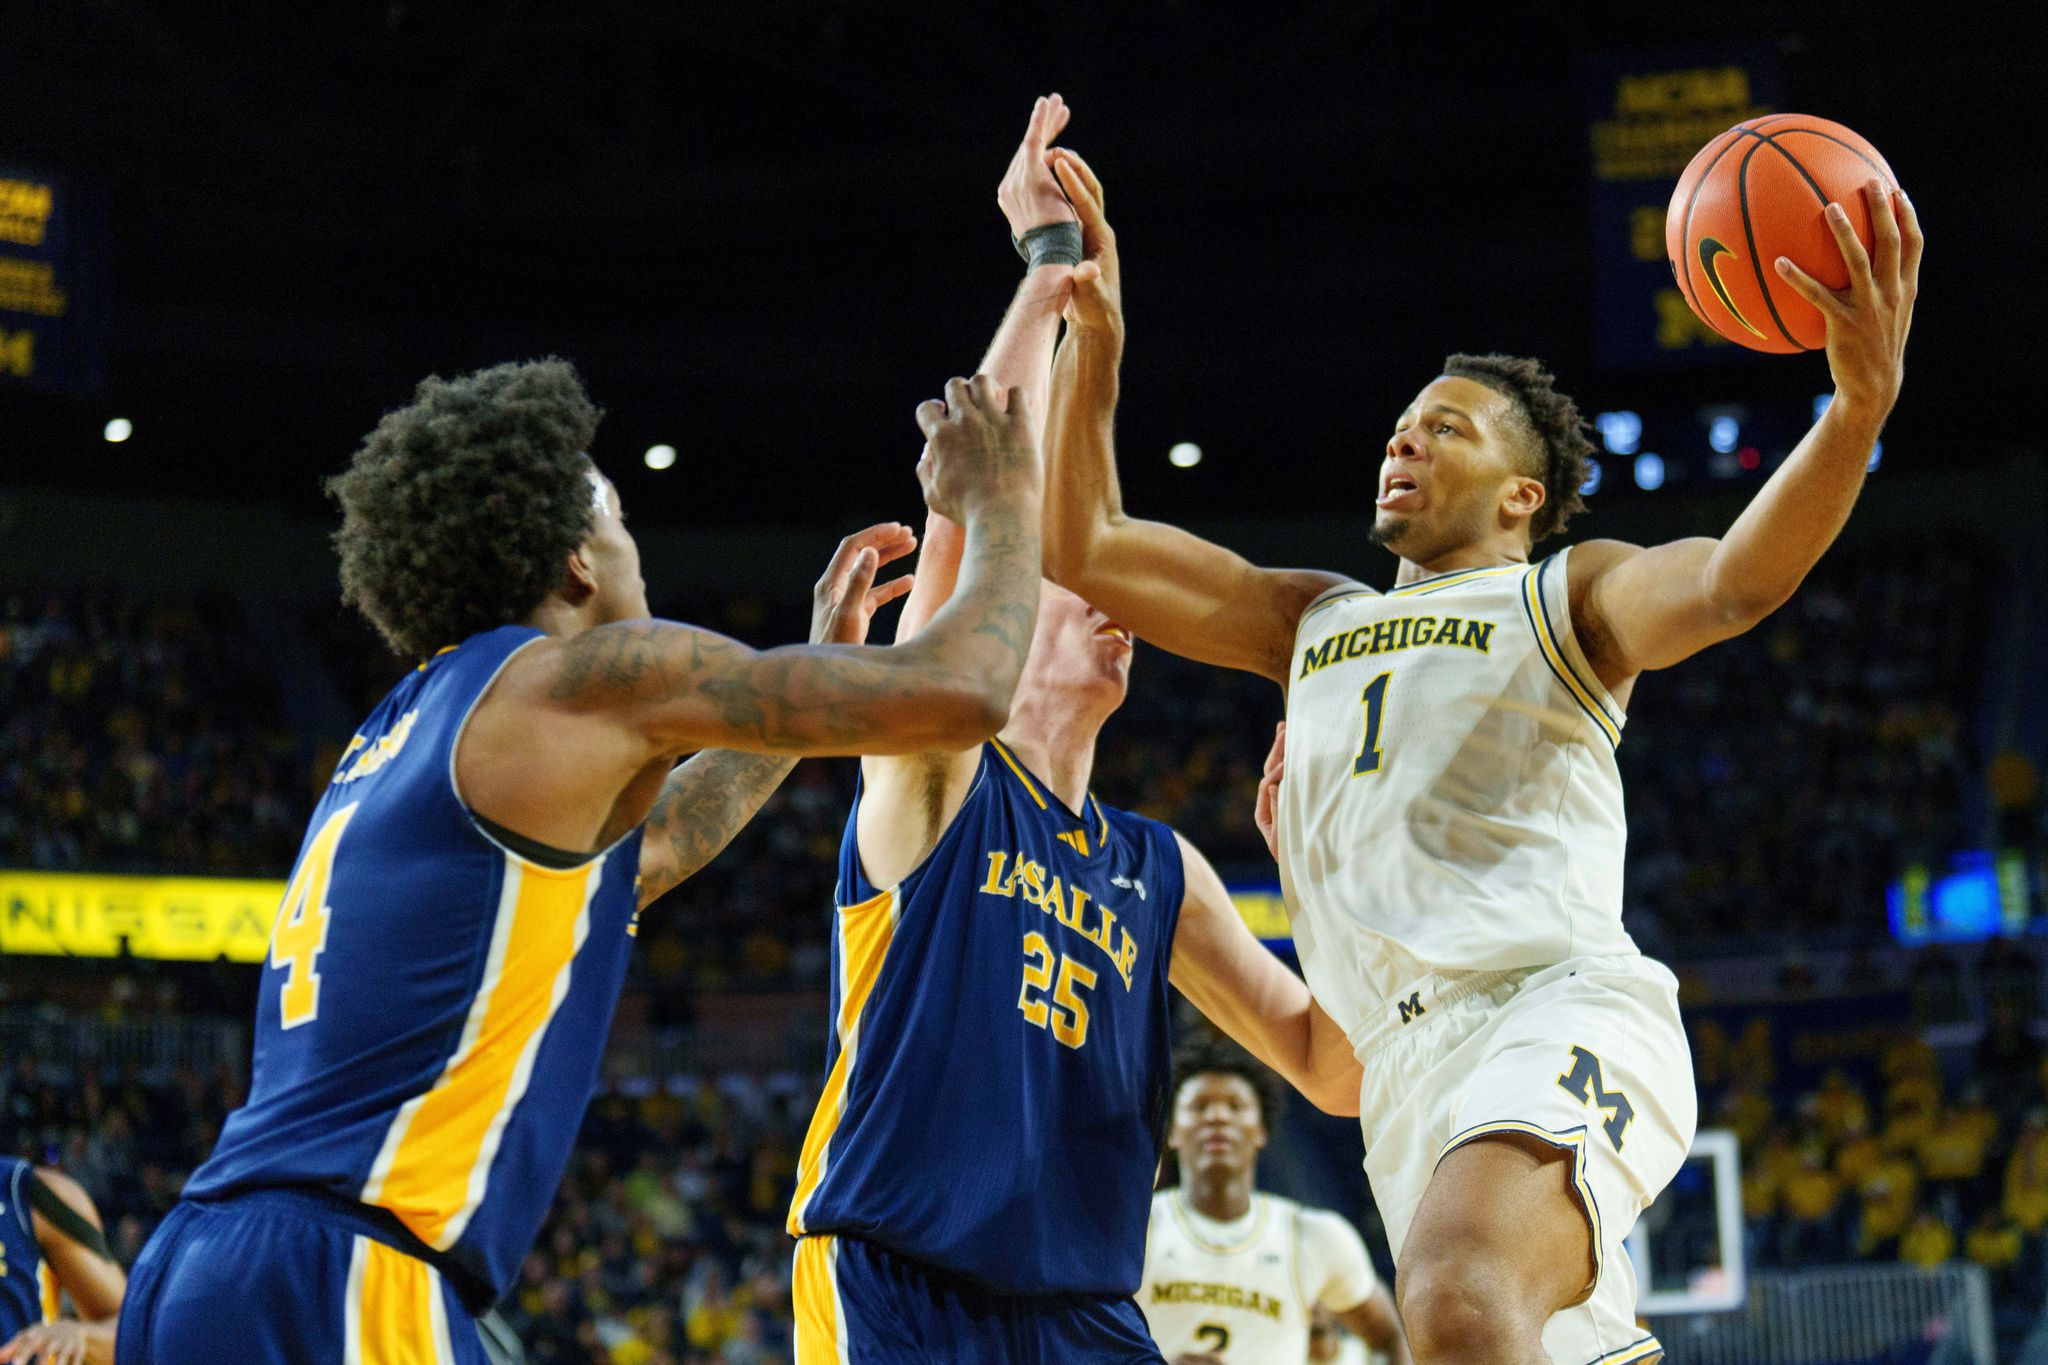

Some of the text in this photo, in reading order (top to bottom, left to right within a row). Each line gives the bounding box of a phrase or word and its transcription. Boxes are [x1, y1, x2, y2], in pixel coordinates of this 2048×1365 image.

[1299, 616, 1496, 681] MICHIGAN
[1352, 671, 1392, 778] 1
[270, 801, 360, 1030] 4
[1017, 931, 1097, 1050] 25
[1397, 991, 1426, 1024] M
[1555, 1043, 1635, 1154] M
[1151, 1281, 1282, 1320] MICHIGAN
